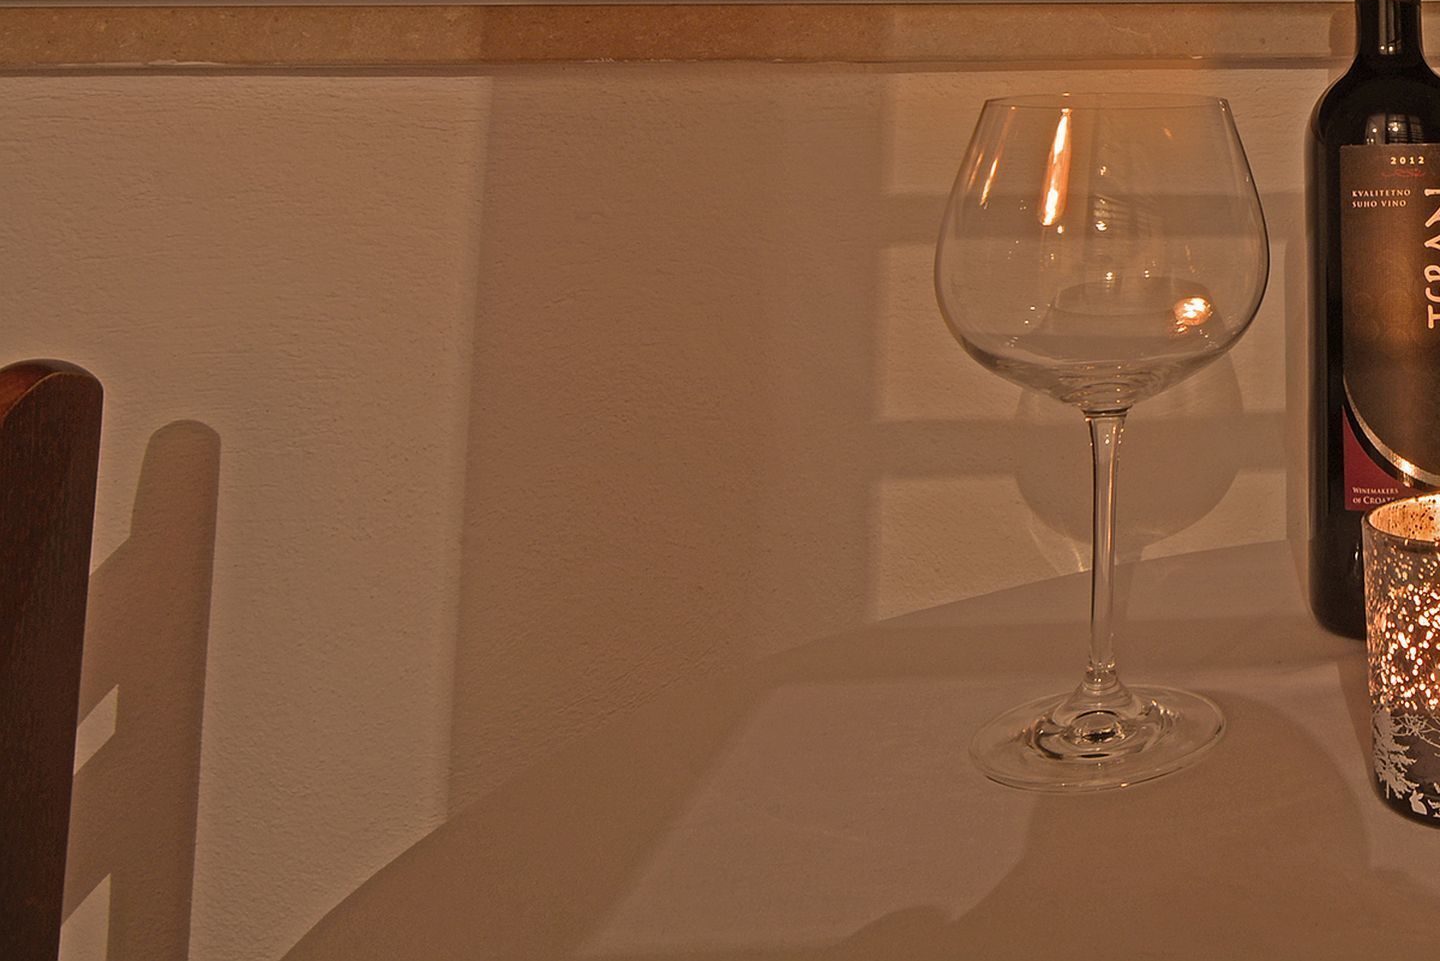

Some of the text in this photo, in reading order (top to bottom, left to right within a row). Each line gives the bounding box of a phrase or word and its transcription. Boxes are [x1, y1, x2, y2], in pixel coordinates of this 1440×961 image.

[1391, 156, 1425, 165] 2012
[1352, 189, 1411, 197] KVALITETNO
[1352, 200, 1377, 208] SUHO
